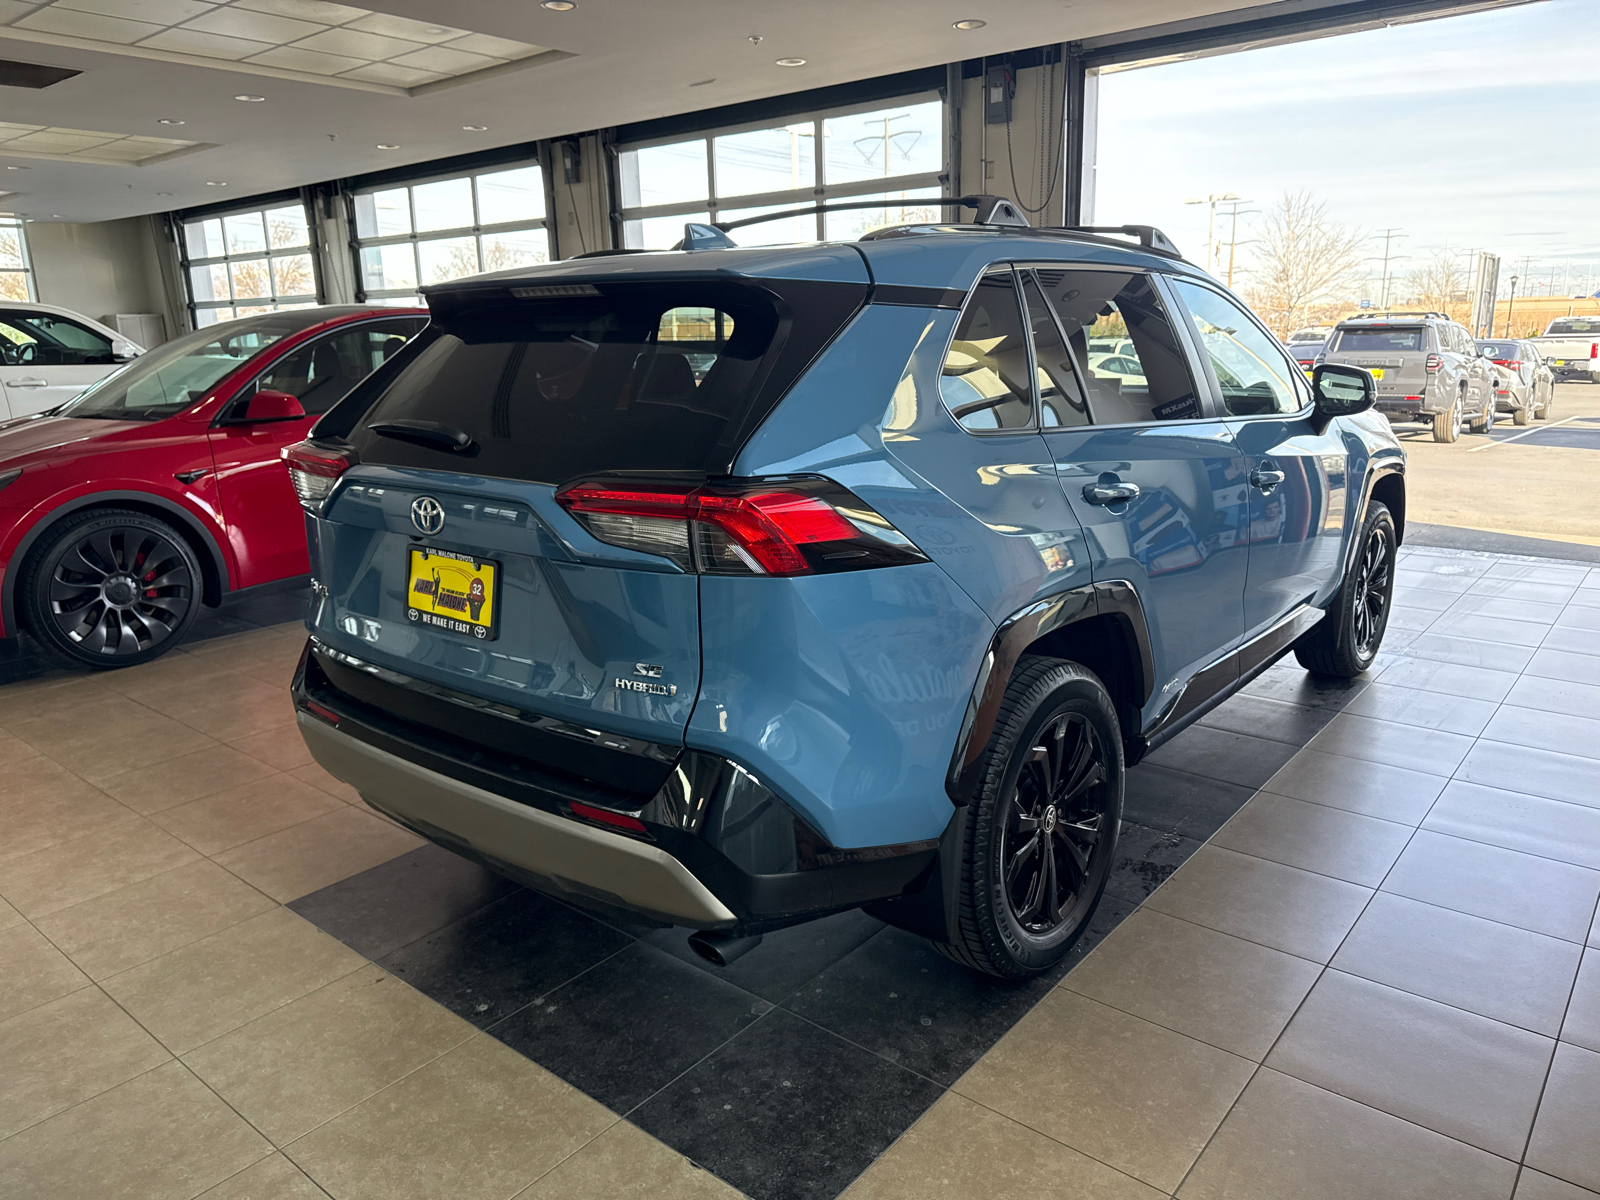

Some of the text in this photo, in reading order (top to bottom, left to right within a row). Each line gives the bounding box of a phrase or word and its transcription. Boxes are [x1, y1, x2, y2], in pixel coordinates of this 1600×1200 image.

[425, 547, 437, 555] KARL
[457, 553, 474, 563] TOYOTA
[413, 577, 435, 595] KARL
[472, 583, 482, 595] 32
[437, 592, 468, 613] MALONE
[422, 613, 470, 633] WE MAKE IT EASY
[633, 662, 664, 678] SE
[993, 887, 1022, 953] MICHELIN
